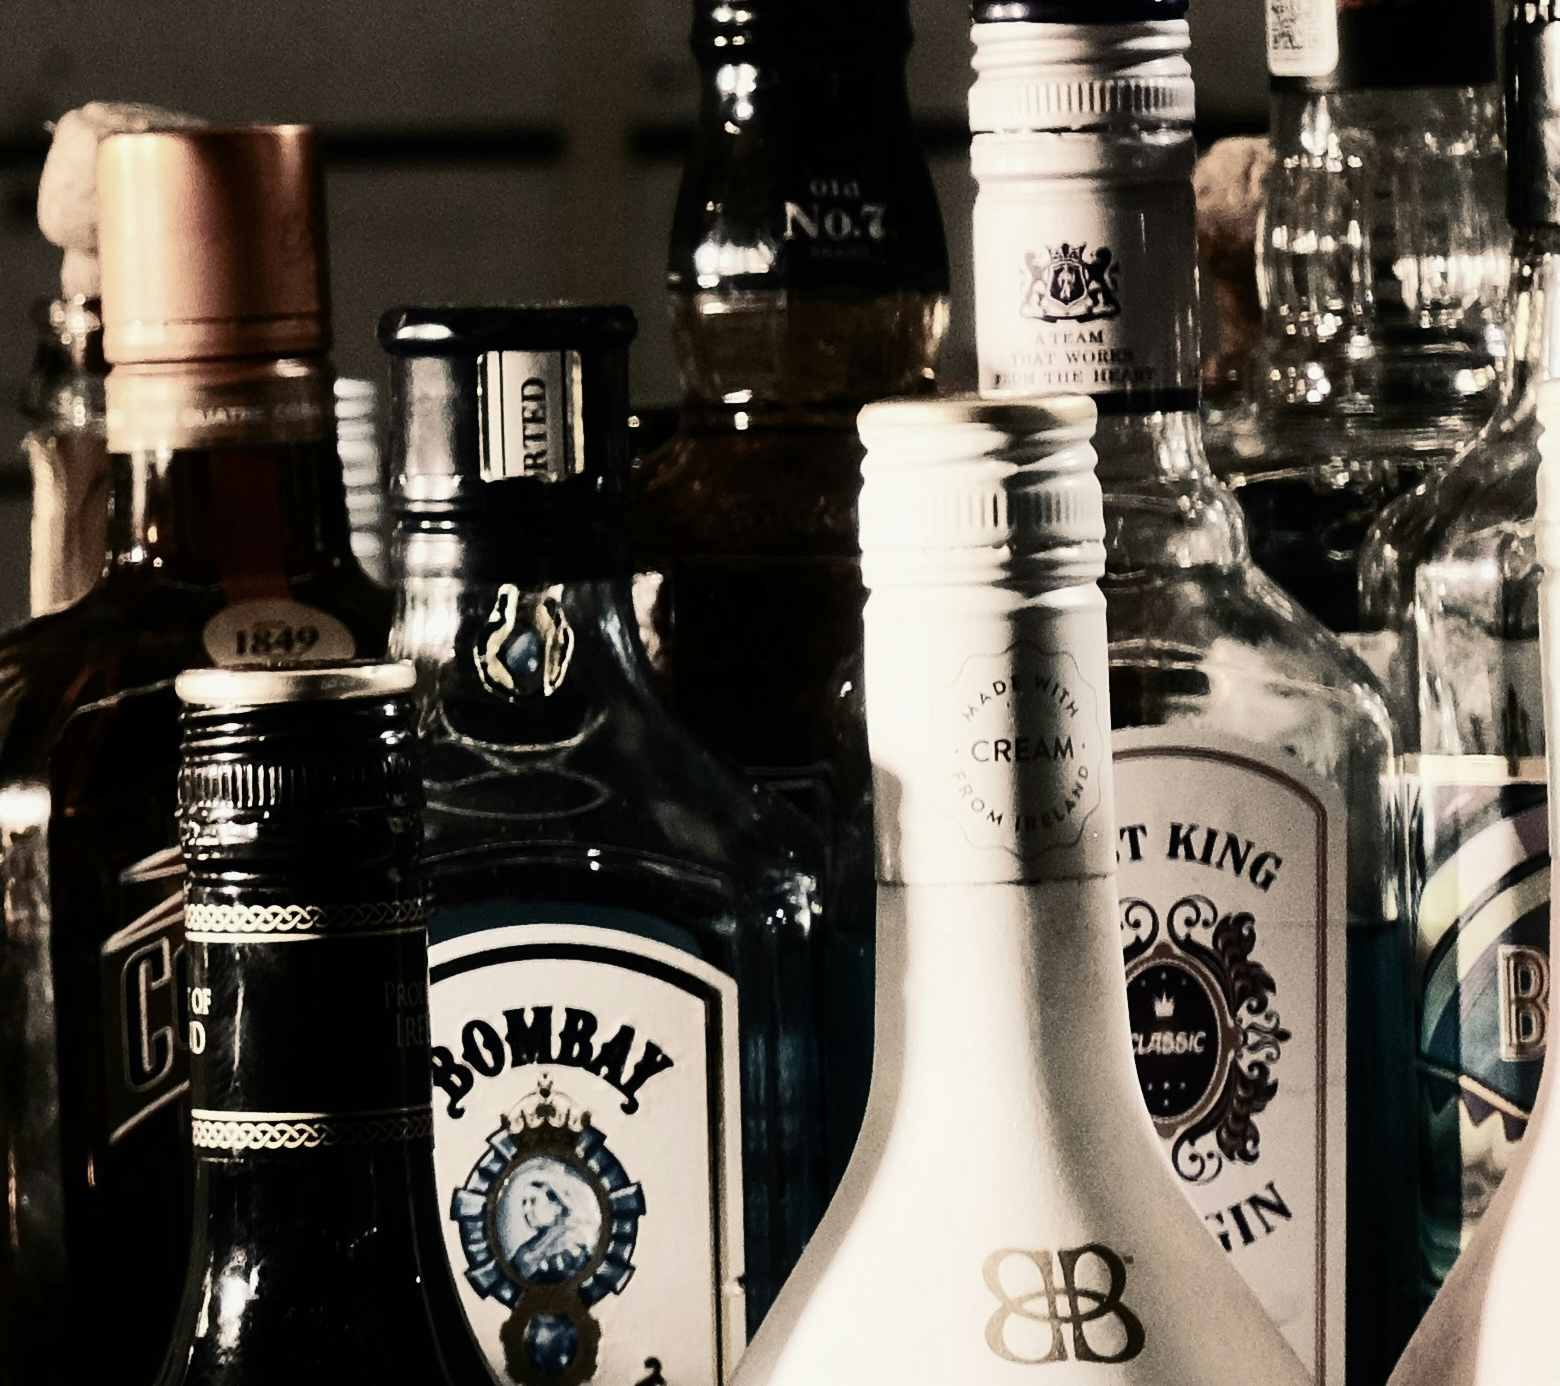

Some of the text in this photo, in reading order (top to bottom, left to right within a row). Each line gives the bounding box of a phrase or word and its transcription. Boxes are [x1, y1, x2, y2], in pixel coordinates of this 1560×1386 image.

[782, 199, 888, 242] No.7
[1049, 329, 1105, 345] TEAM
[236, 625, 320, 659] 1849
[960, 674, 1080, 722] MADE WITH
[971, 735, 1075, 763] CREAM
[1013, 764, 1090, 832] IRELAND
[1166, 821, 1284, 893] KING
[431, 1005, 674, 1119] BOMBAY
